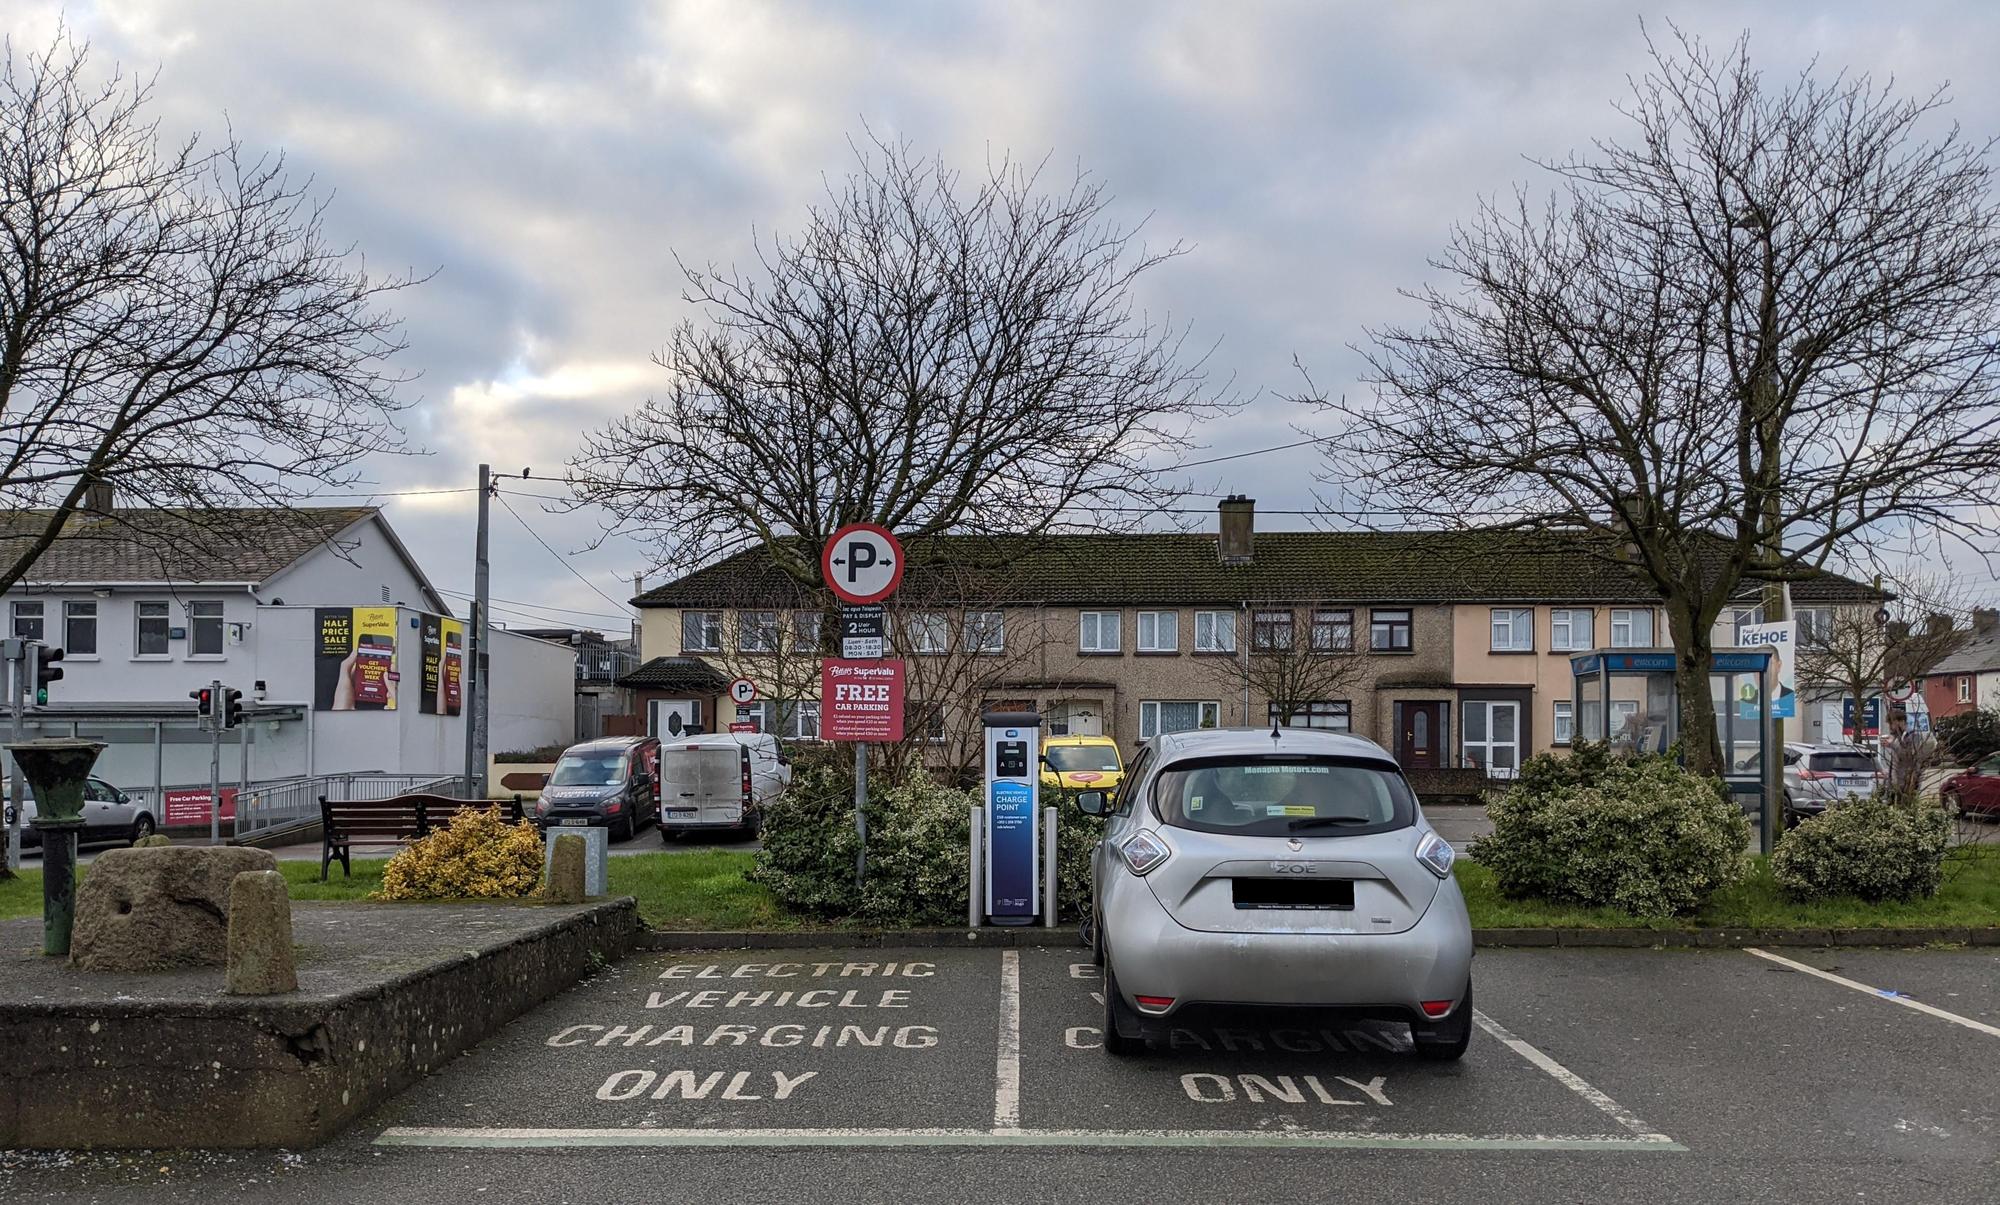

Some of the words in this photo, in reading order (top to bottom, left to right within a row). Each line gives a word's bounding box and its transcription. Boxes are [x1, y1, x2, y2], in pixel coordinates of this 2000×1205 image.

[848, 542, 876, 582] P
[849, 622, 858, 634] 2
[1742, 630, 1788, 646] KEHOE
[426, 655, 438, 663] HALF
[359, 662, 388, 671] VOUCHERS
[425, 665, 438, 673] PRICE
[853, 666, 894, 677] SuperValu
[426, 673, 438, 681] SALE
[738, 684, 748, 698] P
[835, 684, 890, 702] FREE
[1745, 685, 1751, 699] 1
[853, 703, 889, 711] PARKING
[1281, 765, 1329, 774] Motors.com
[996, 803, 1019, 811] POINT
[1276, 864, 1317, 874] ZOE
[659, 962, 935, 979] ELECTRIC
[645, 989, 911, 1009] VEHICLE
[545, 1023, 939, 1049] CHARGING
[595, 1069, 819, 1101] ONLY
[1179, 1072, 1394, 1106] ONLY
